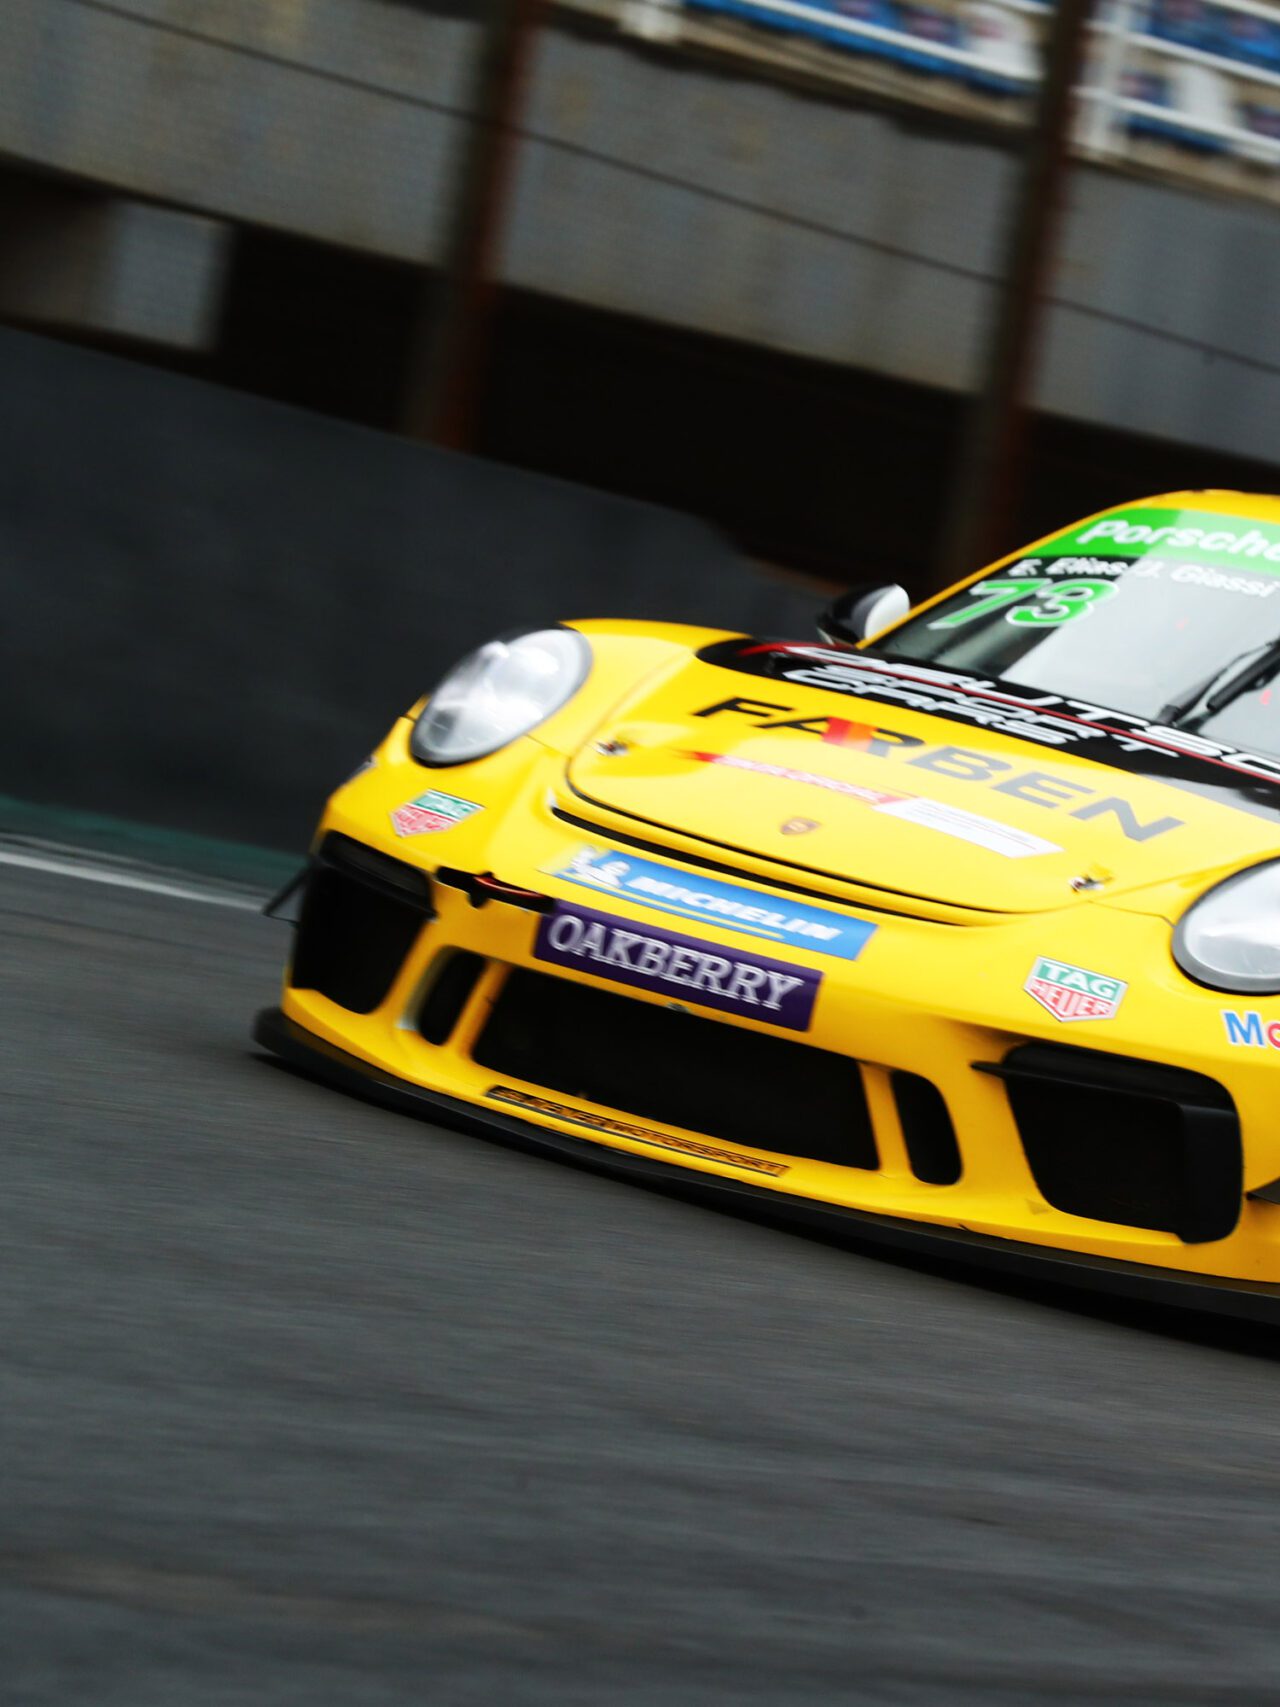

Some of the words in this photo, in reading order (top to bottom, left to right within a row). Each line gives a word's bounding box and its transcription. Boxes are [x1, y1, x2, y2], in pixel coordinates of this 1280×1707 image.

[927, 578, 1121, 629] 73
[812, 664, 1181, 758] SPORT
[690, 697, 1185, 843] FARBEN
[625, 875, 844, 943] MICHELIN
[547, 913, 806, 1011] OAKBERRY
[1041, 963, 1118, 1000] TAG
[1030, 980, 1113, 1019] HEUER
